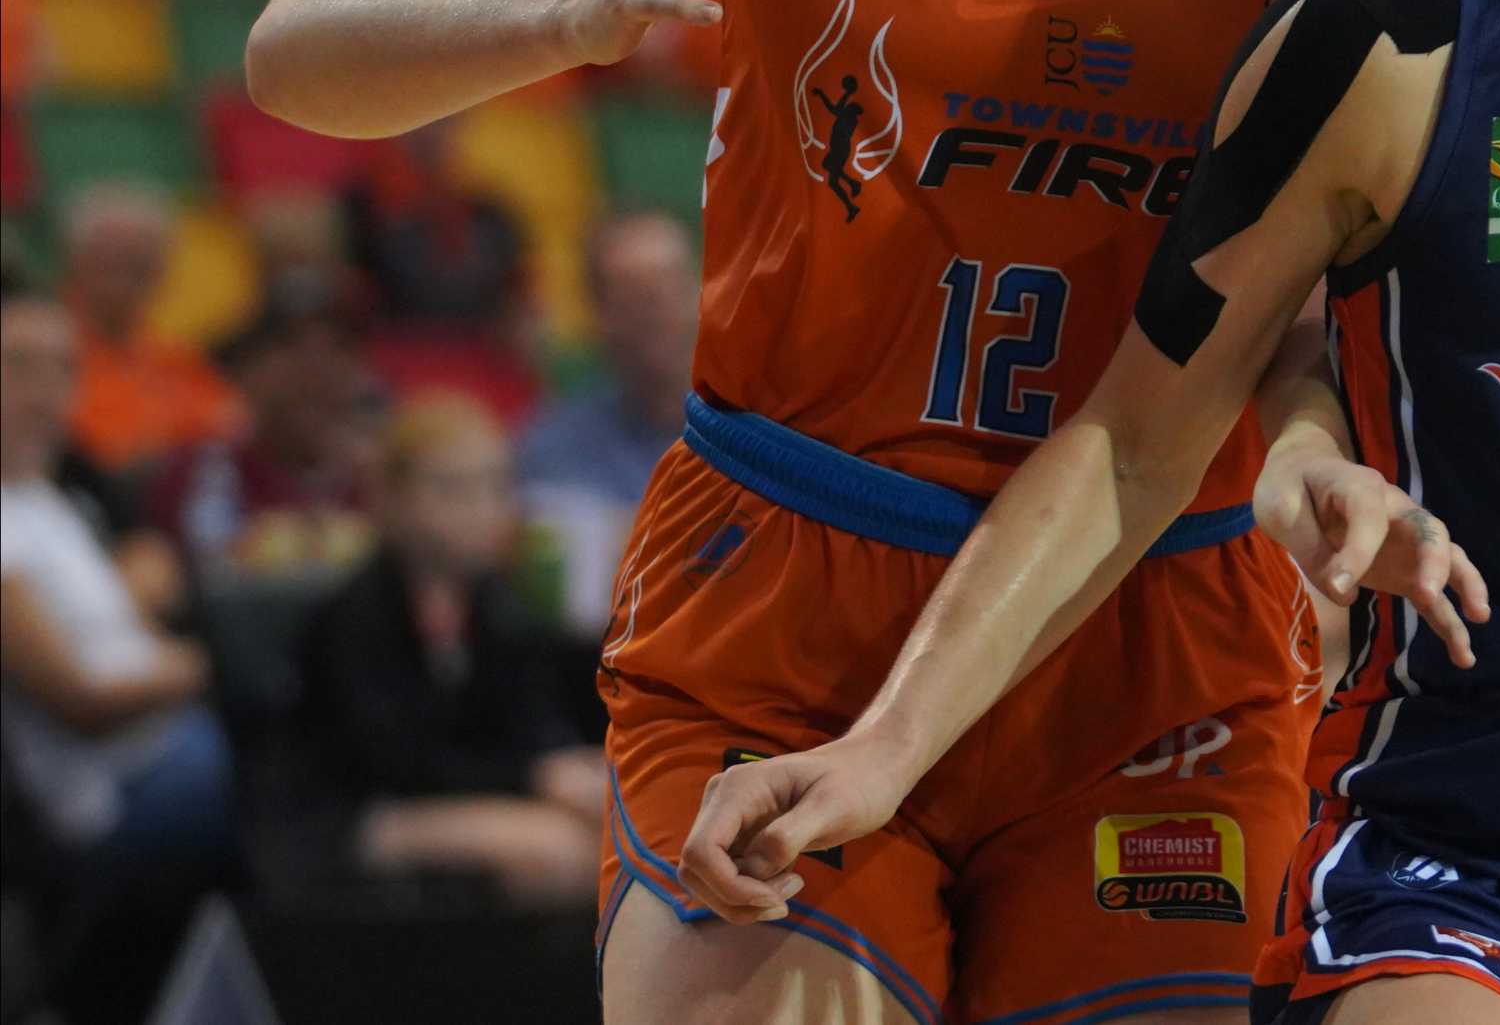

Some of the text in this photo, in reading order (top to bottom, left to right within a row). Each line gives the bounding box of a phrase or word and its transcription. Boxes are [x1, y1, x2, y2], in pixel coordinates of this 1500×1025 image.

[1045, 15, 1080, 92] JCU
[943, 91, 1210, 148] TOWNSVILL
[916, 127, 1197, 217] FIRE
[919, 255, 1071, 442] 12
[1124, 837, 1216, 855] CHEMIST
[1136, 881, 1235, 904] WNBL
